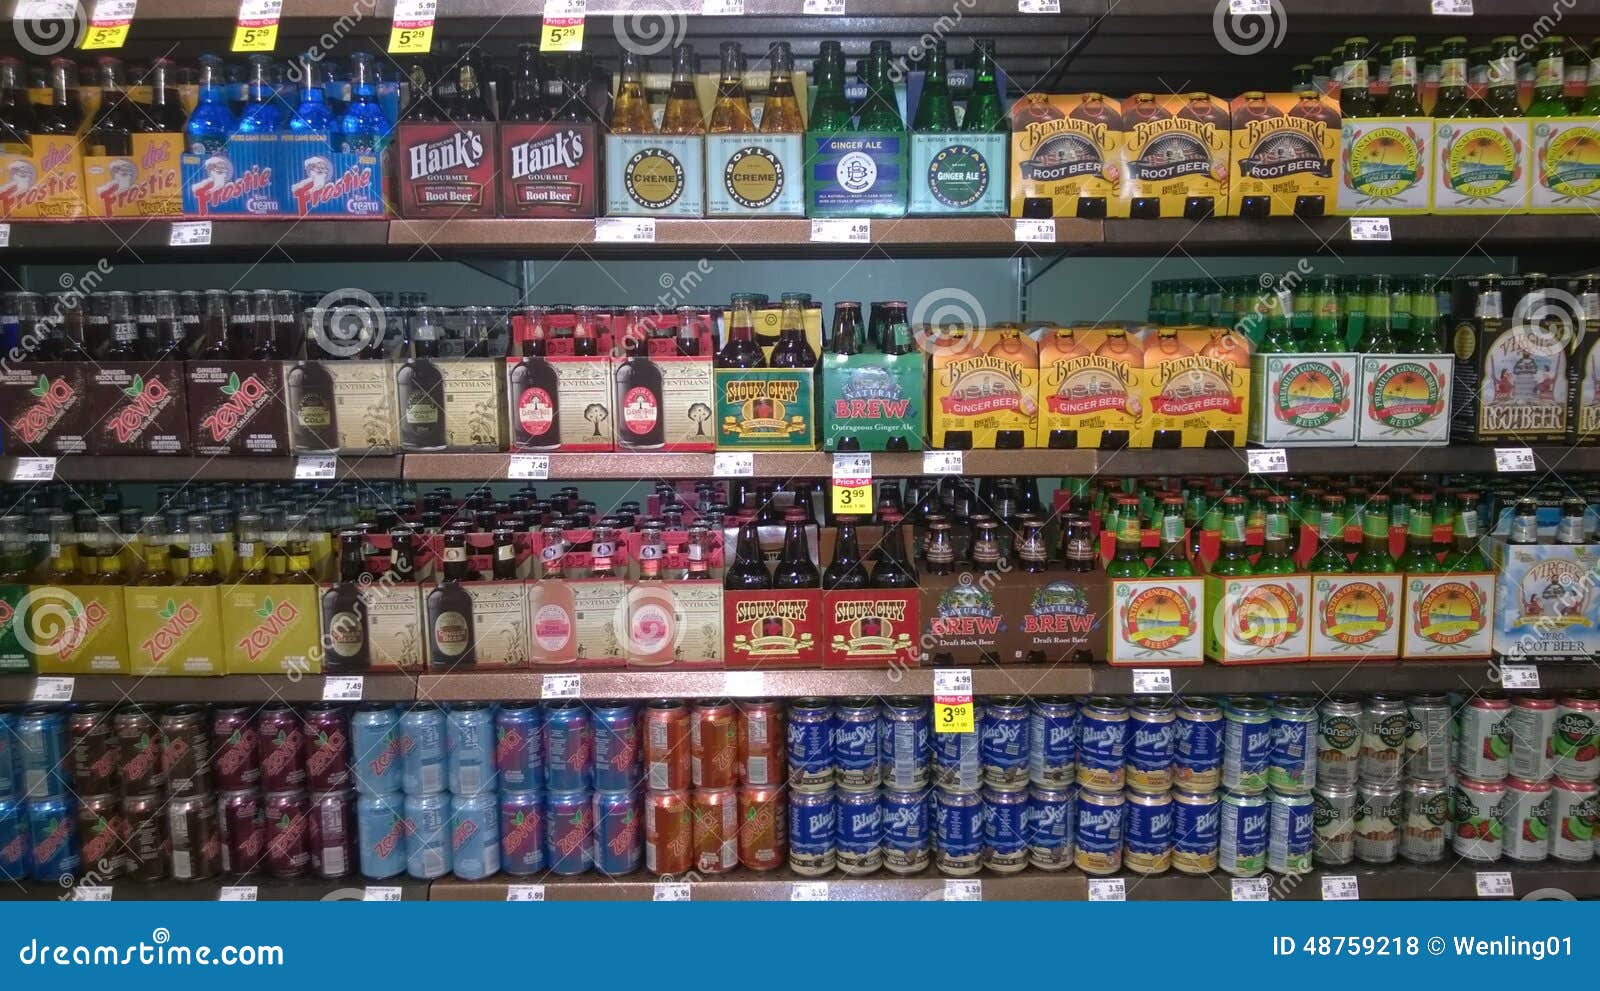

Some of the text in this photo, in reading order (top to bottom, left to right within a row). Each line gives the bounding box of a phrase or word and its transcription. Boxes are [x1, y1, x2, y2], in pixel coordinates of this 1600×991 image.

[410, 130, 484, 179] Hank's
[511, 130, 584, 179] Hank's
[1033, 162, 1101, 178] ROOT BEER
[1141, 162, 1210, 178] ROOT BEER
[1252, 160, 1320, 177] ROOT BEER
[634, 174, 676, 183] CREME
[733, 173, 775, 182] CREME
[938, 171, 980, 181] GINGER ALE
[96, 168, 177, 219] Frostie
[192, 164, 271, 216] Frostie
[292, 164, 371, 216] Frostie
[426, 191, 473, 201] Root Beer
[526, 191, 572, 201] Root Beer
[247, 198, 279, 213] Cream
[347, 198, 379, 212] Cream
[193, 229, 210, 237] 3.79
[727, 381, 799, 403] SIOUX CITY
[846, 391, 899, 400] NATURAL
[835, 399, 909, 418] BREW
[953, 399, 1019, 412] GINGER BEER
[1059, 398, 1125, 412] GINGER BEER
[1163, 398, 1230, 412] GINGER BEER
[831, 423, 914, 432] Outrageous Ginger Ale
[531, 461, 548, 469] 7.49
[736, 599, 809, 622] SIOUX CITY
[835, 599, 907, 622] SIOUX CITY
[1032, 605, 1088, 616] NATURAL
[930, 616, 1001, 635] BREW
[1024, 615, 1096, 633] BREW
[1071, 636, 1088, 644] Beer
[1558, 640, 1587, 652] BEER
[1154, 676, 1170, 684] 4.99
[1566, 716, 1590, 728] Diet
[1108, 885, 1124, 893] 3.59
